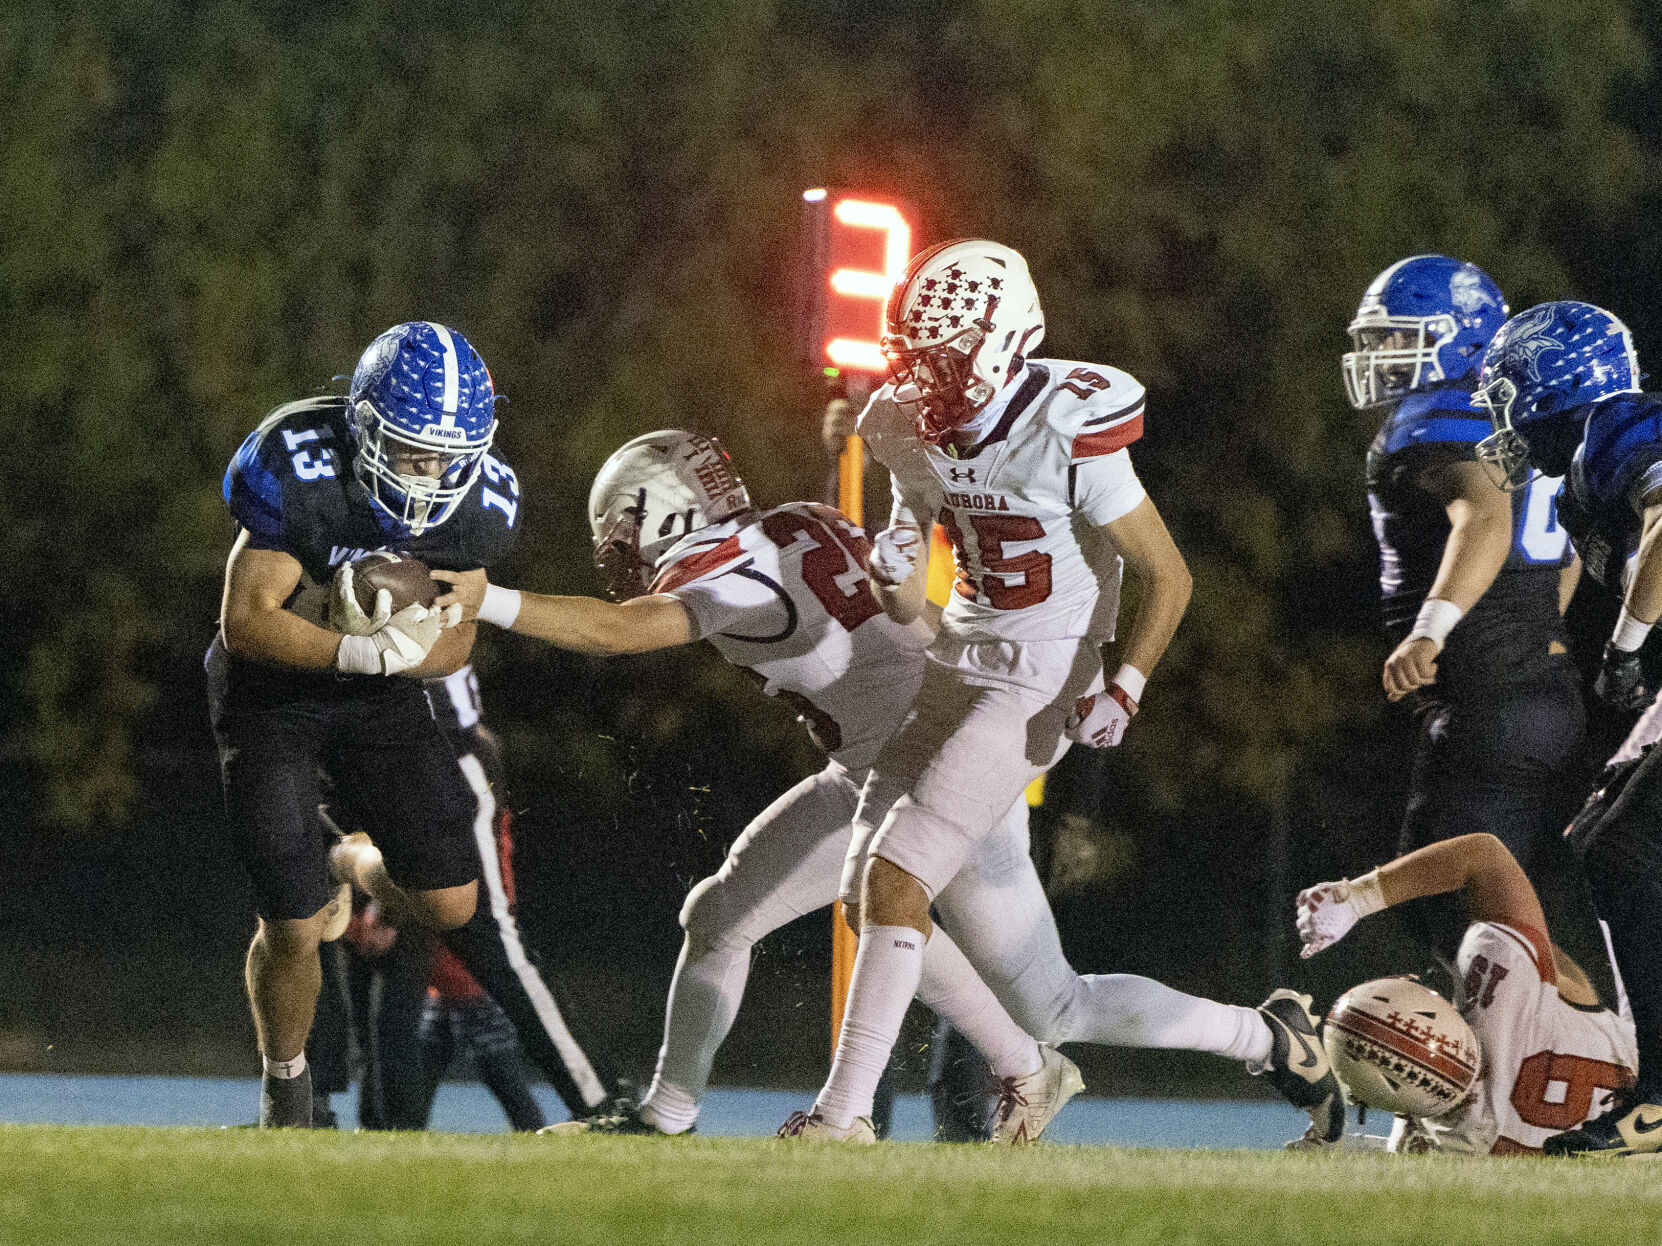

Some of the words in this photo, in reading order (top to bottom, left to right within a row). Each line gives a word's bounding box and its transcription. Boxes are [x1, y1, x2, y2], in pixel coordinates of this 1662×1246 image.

[827, 199, 912, 373] 3
[1050, 367, 1112, 400] 15
[280, 428, 336, 482] 13
[429, 427, 462, 439] VIKINGS
[480, 453, 520, 530] 13
[939, 506, 1053, 611] 15
